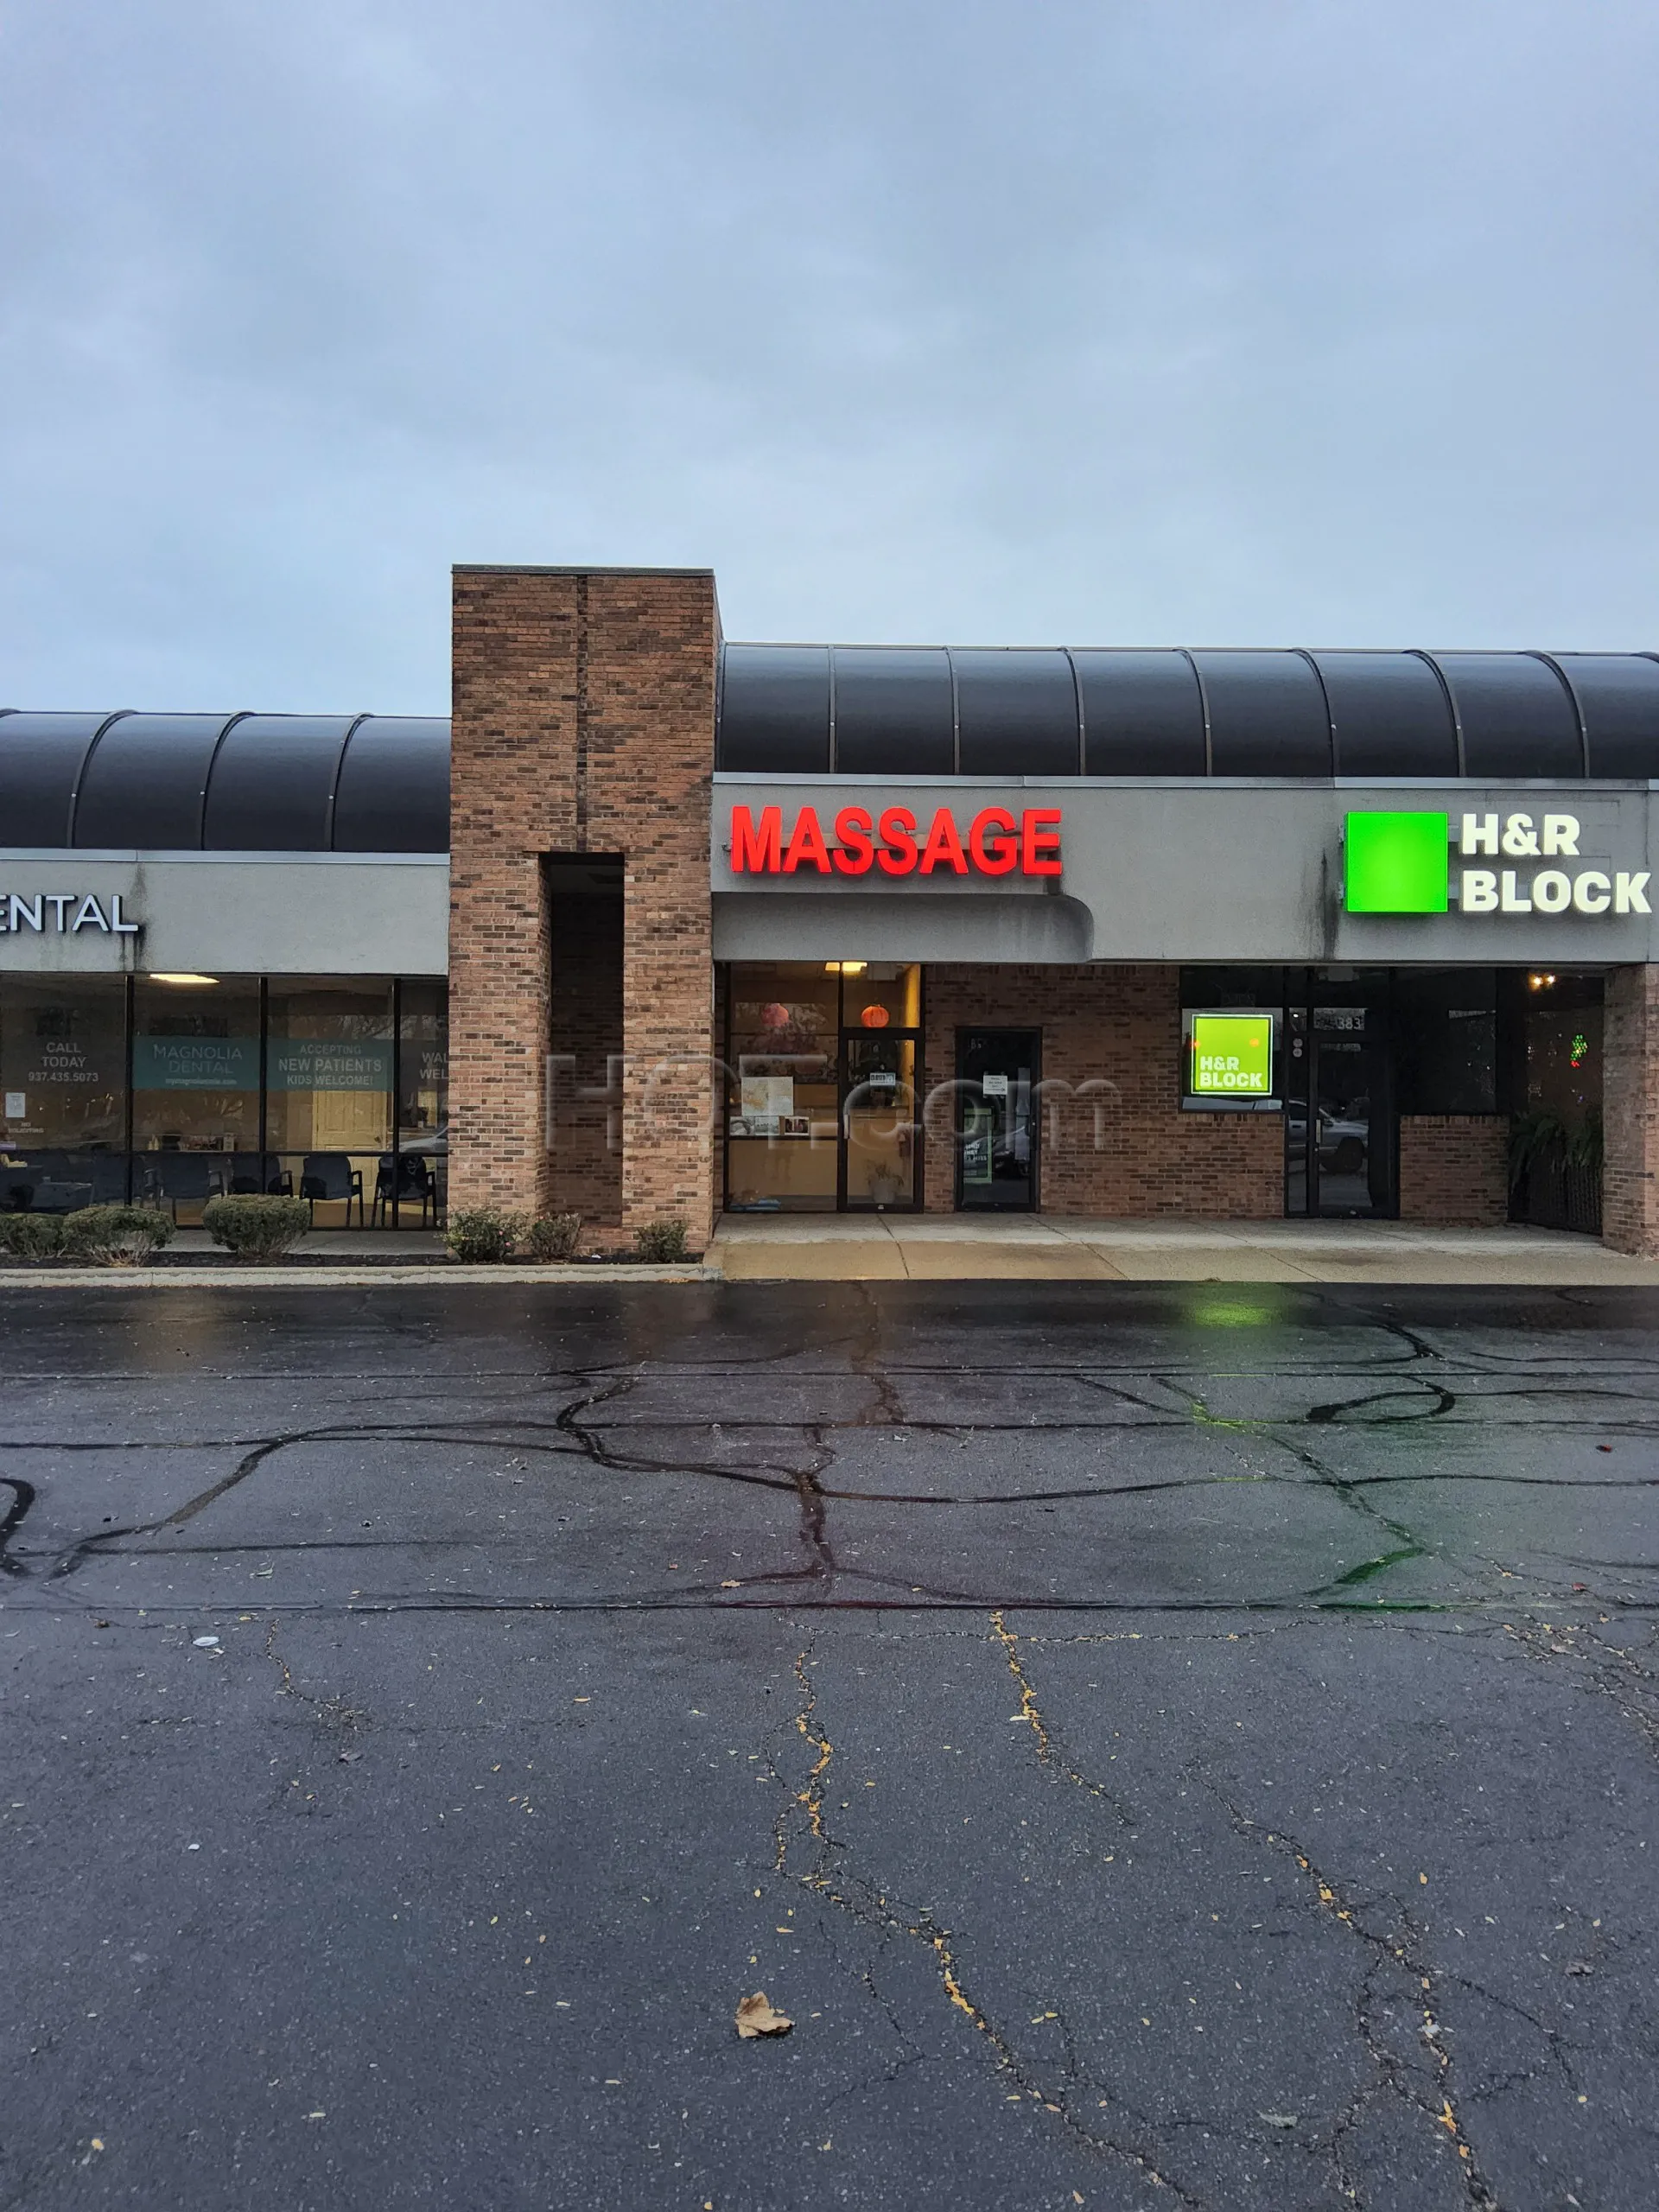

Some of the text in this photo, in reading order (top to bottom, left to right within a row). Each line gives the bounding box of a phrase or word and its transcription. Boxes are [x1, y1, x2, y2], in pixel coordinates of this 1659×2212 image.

[732, 805, 1062, 876] MASSAGE
[1462, 813, 1580, 855] H&R
[1463, 870, 1652, 913] BLOCK
[0, 894, 138, 931] NTAL
[46, 1042, 81, 1053] CALL
[153, 1044, 243, 1059] MAGNOLIA
[300, 1044, 362, 1055] ACCEPTING
[41, 1056, 87, 1067] TODAY
[168, 1060, 234, 1074] DENTAL
[278, 1058, 382, 1072] NEW PATIENTS
[1199, 1056, 1239, 1071] H&R
[28, 1071, 99, 1082] 937.435.5073
[287, 1075, 373, 1085] KIDS WELCOME!
[1199, 1072, 1262, 1087] BLOCK
